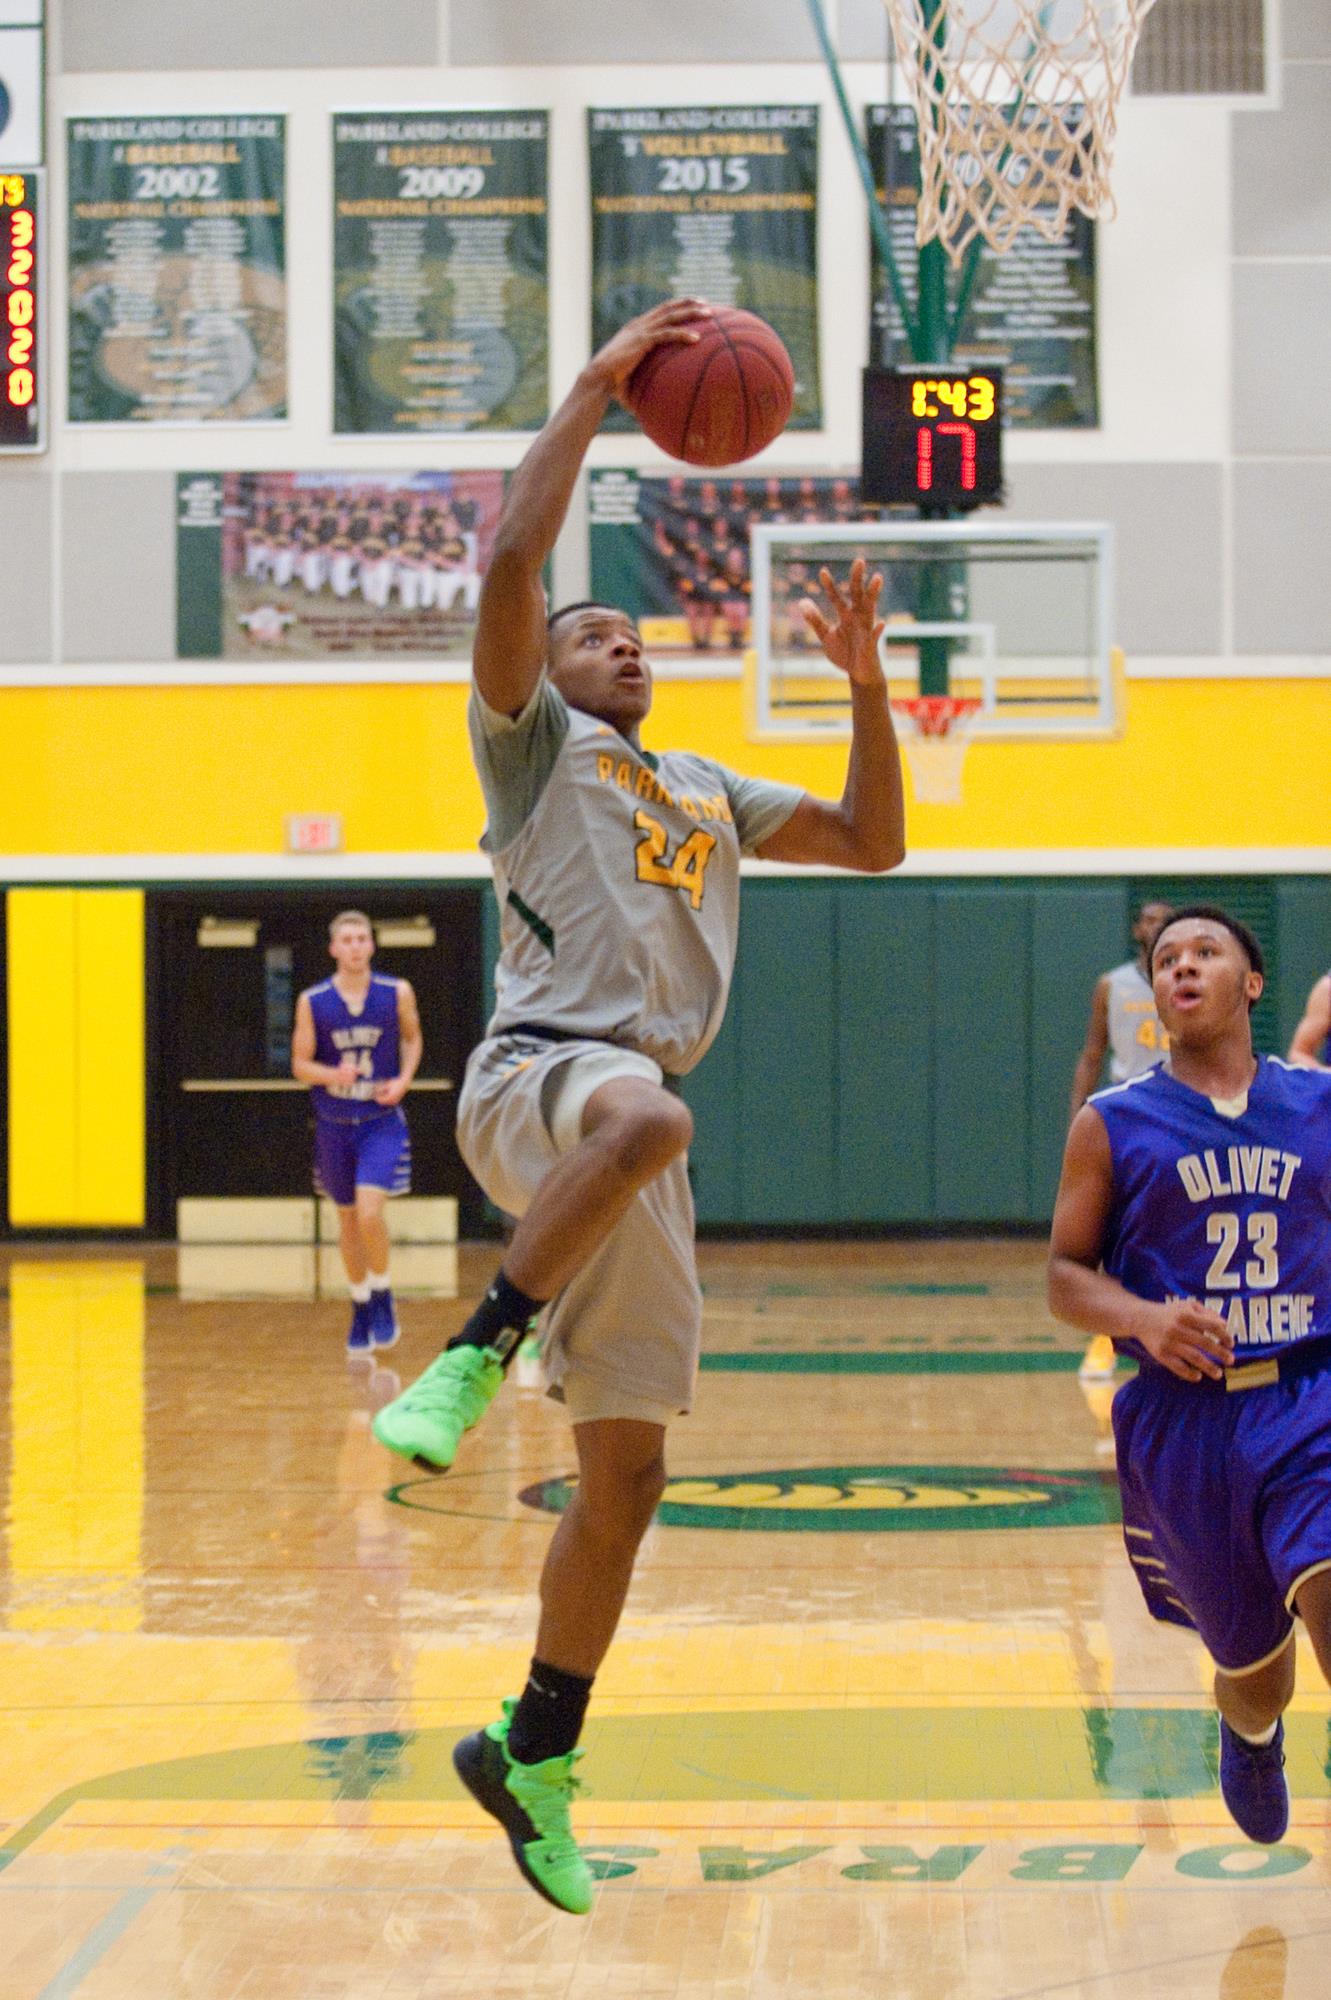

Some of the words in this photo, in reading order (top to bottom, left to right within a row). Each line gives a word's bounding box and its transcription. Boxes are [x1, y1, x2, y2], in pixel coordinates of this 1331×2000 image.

[136, 166, 220, 198] 2002
[399, 166, 486, 198] 2009
[658, 157, 750, 192] 2015
[10, 208, 34, 248] 3
[7, 248, 34, 287] 2
[7, 288, 34, 327] 0
[7, 327, 34, 366] 2
[7, 367, 34, 407] 0
[911, 377, 995, 421] 1:43
[916, 422, 977, 491] 17
[633, 807, 717, 911] 24
[1176, 1145, 1302, 1203] OLIVET
[1205, 1211, 1280, 1290] 23
[1165, 1294, 1318, 1345] ZARENE
